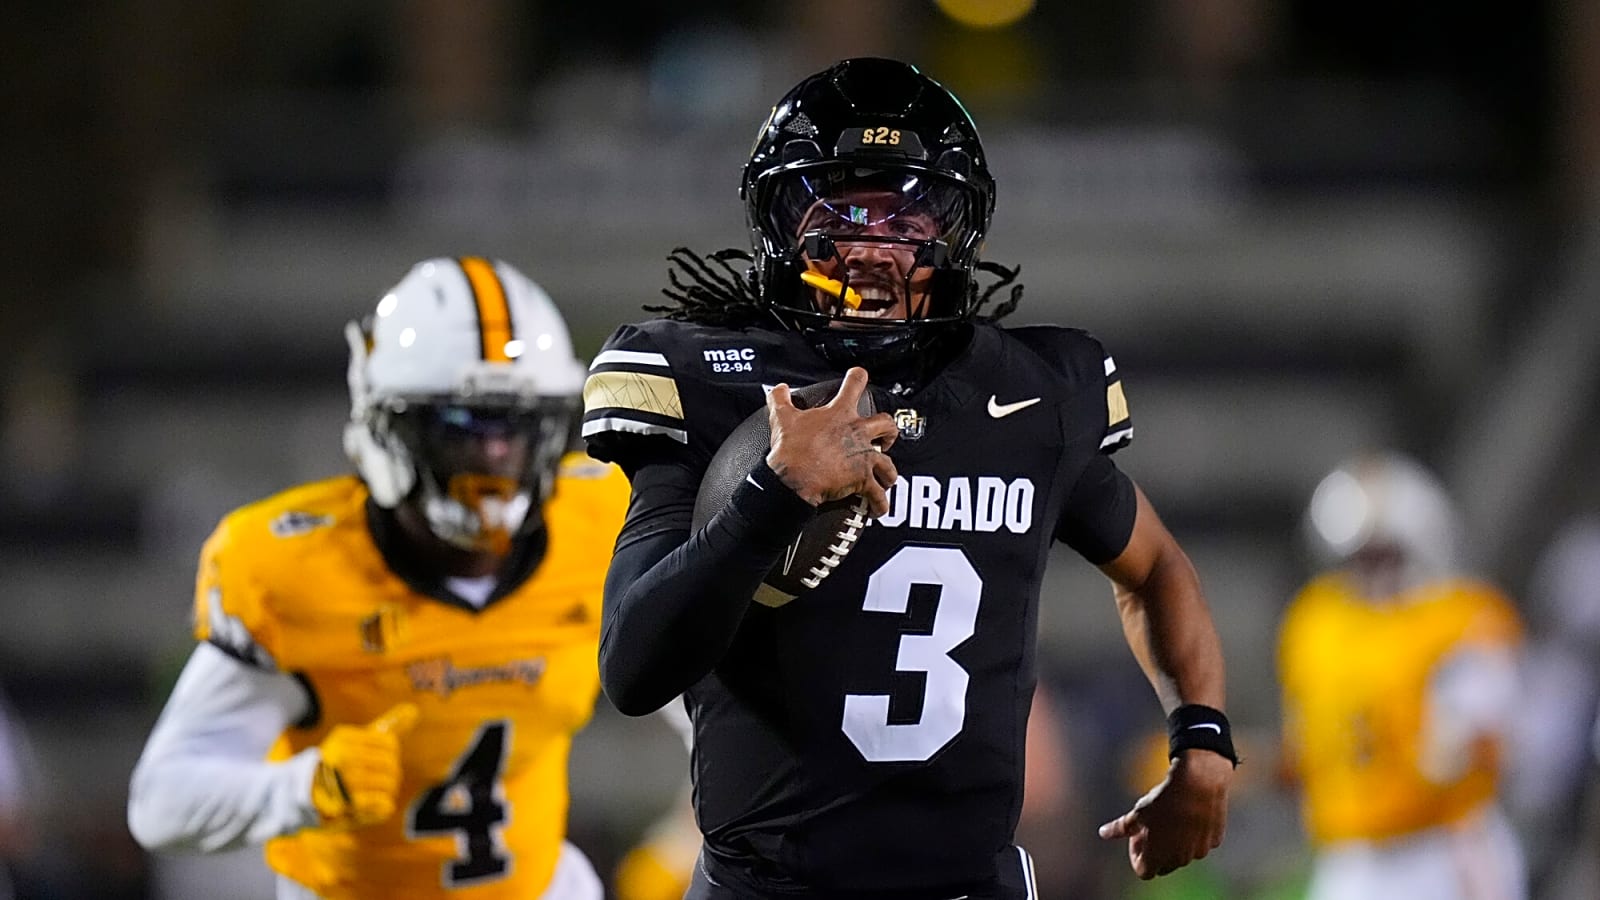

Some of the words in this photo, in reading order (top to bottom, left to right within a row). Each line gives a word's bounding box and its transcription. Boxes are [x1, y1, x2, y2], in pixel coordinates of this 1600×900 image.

[703, 348, 756, 361] mac
[712, 362, 753, 373] 82-94
[866, 474, 1035, 534] ORADO
[841, 546, 983, 762] 3
[405, 718, 512, 890] 4
